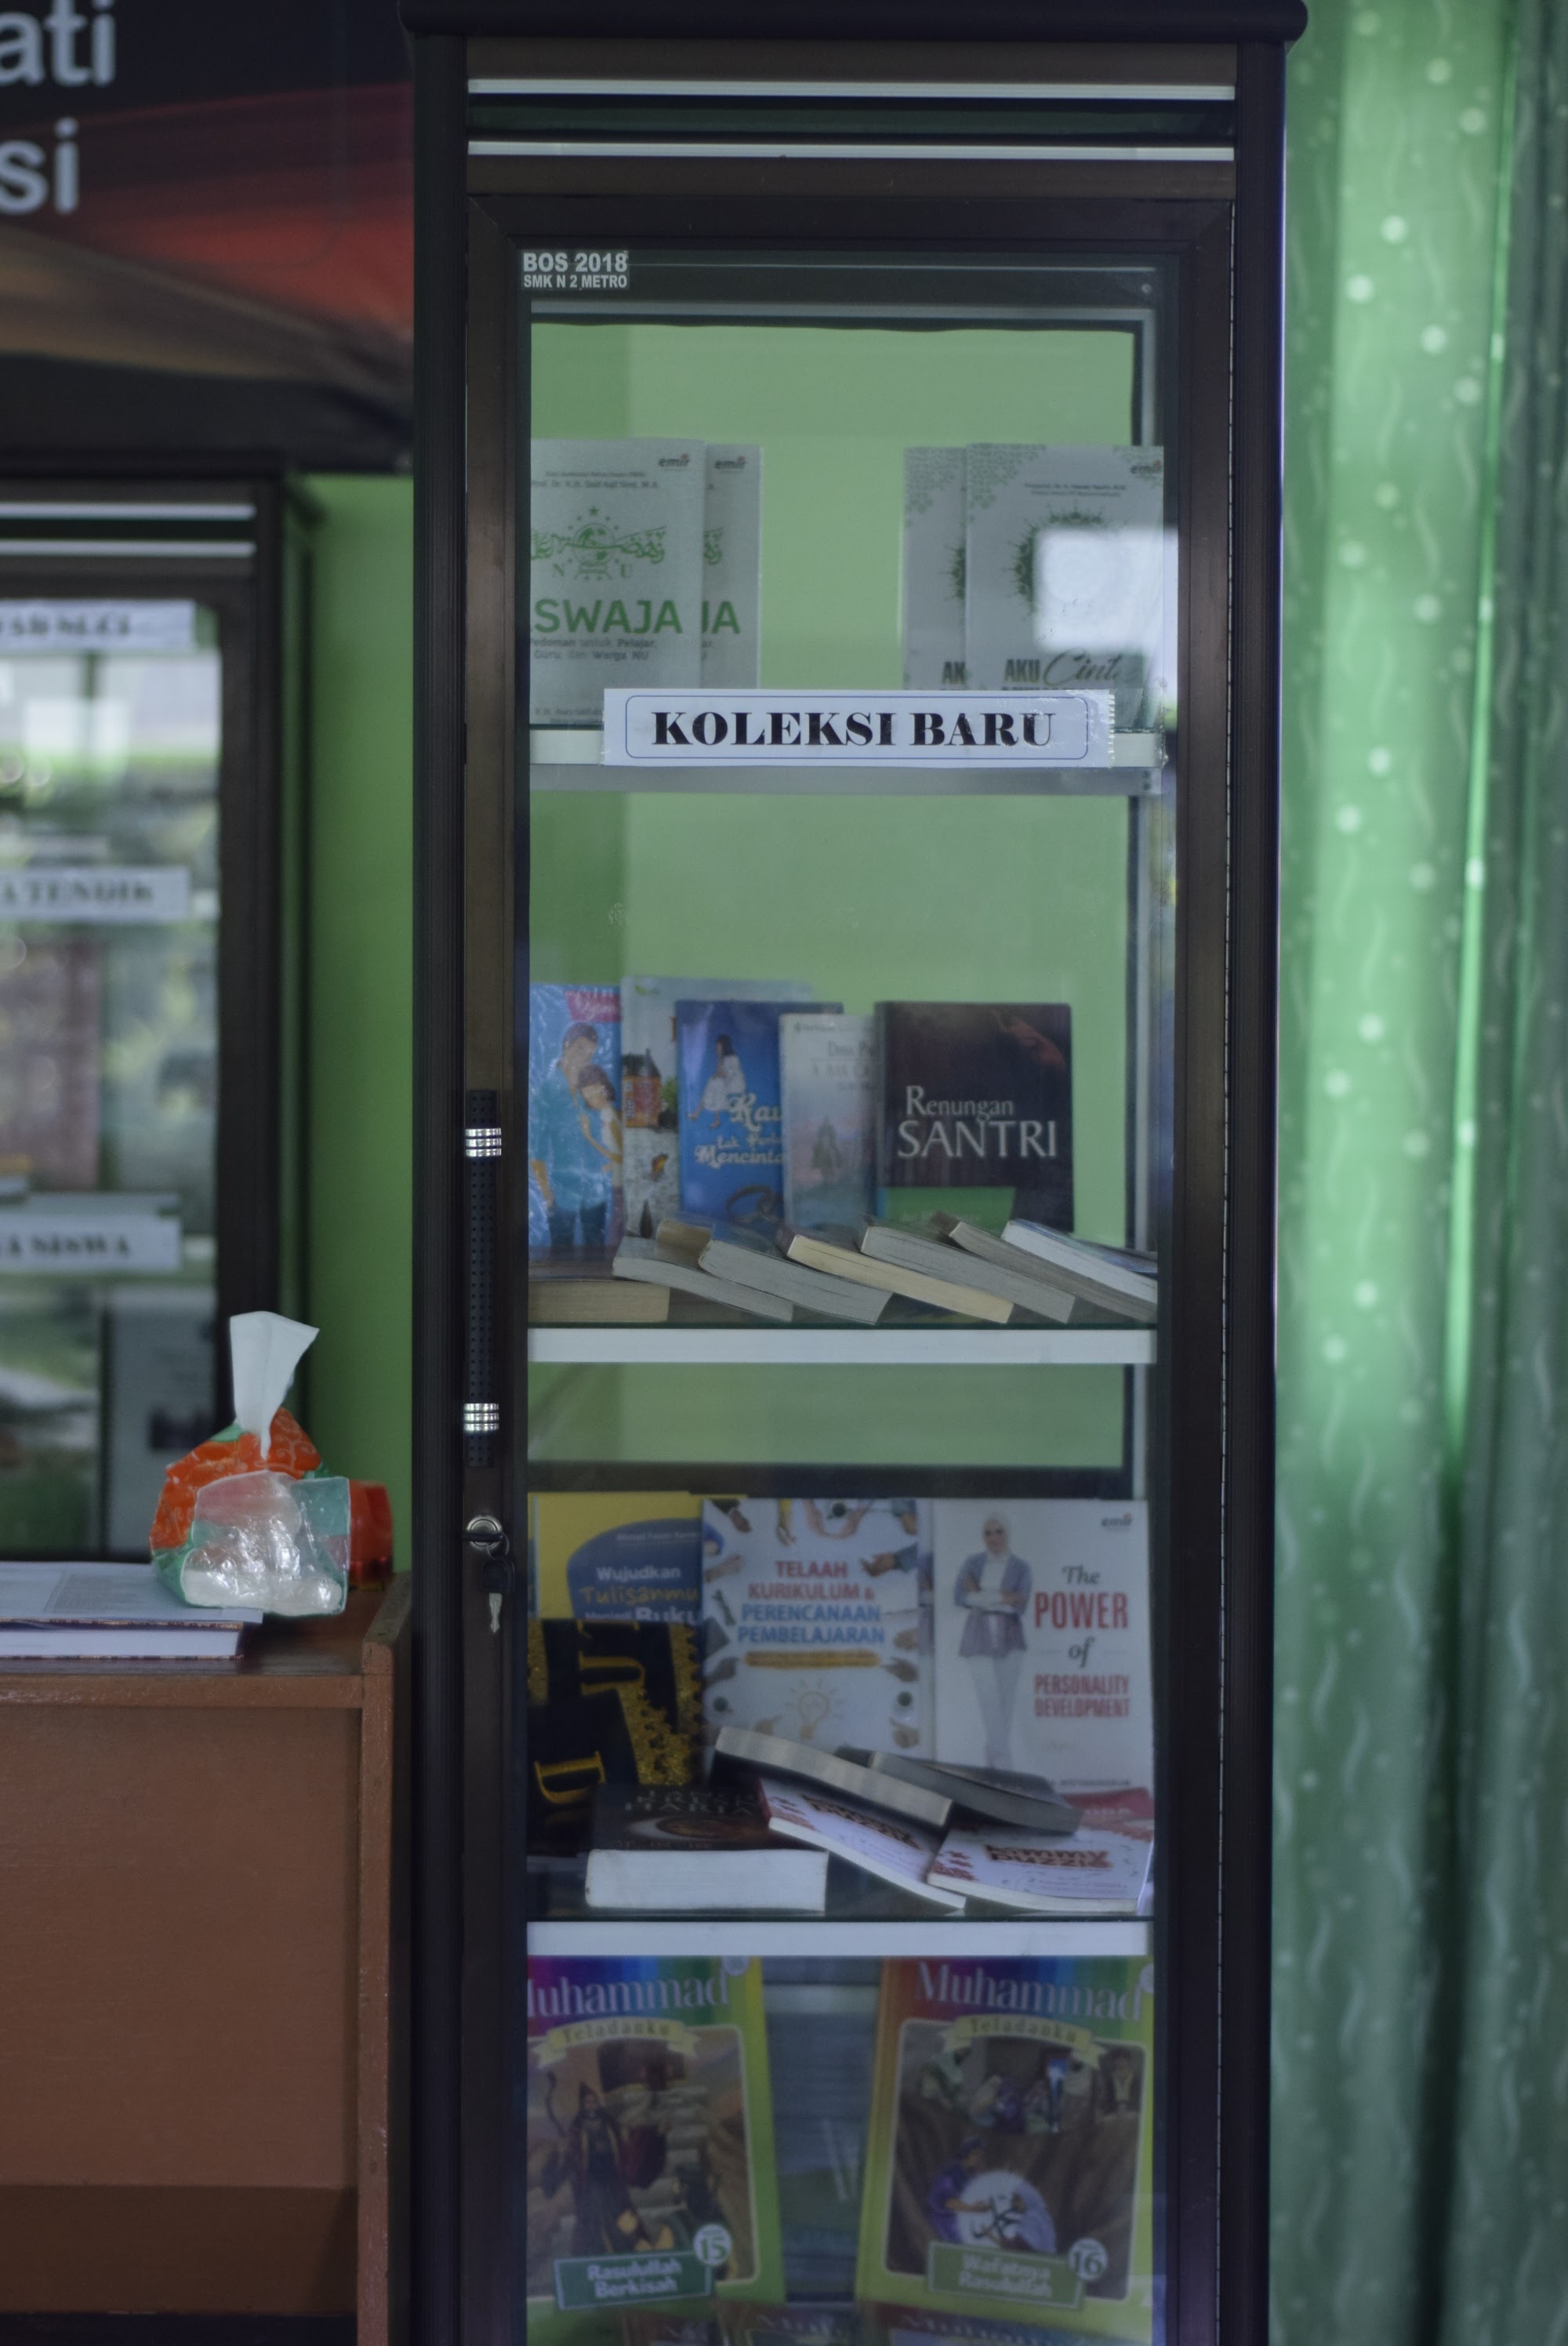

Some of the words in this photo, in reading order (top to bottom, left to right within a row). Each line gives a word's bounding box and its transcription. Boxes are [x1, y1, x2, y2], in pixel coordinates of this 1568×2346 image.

[0, 118, 78, 214] si
[524, 252, 568, 272] BOS
[575, 252, 627, 272] 2018
[524, 274, 553, 288] SMK
[556, 274, 566, 288] N
[569, 274, 578, 288] 2
[581, 274, 627, 288] METRO
[592, 650, 627, 662] Warga
[632, 650, 649, 659] NU
[1004, 659, 1040, 682] AKU
[651, 711, 897, 746] KOLEKSI
[909, 711, 1056, 747] BARU
[906, 1085, 1014, 1123] Renungan
[898, 1120, 1057, 1158] SANTRI
[595, 1565, 681, 1582] Wujudkan
[775, 1560, 848, 1578] TELAAH
[1062, 1564, 1101, 1585] The
[748, 1582, 860, 1600] KURIKULUM
[741, 1603, 882, 1622] PERENCANAAN
[1034, 1592, 1129, 1629] POWER
[737, 1625, 885, 1644] PEMBELAJARAN
[1068, 1636, 1095, 1668] of
[1033, 1673, 1130, 1695] PERSONALITY
[1033, 1697, 1130, 1718] DEVELOPMENT
[528, 1968, 729, 2018] uhammad
[916, 1961, 1143, 2022] Muhammad
[699, 2236, 725, 2260] 15
[1073, 2250, 1102, 2275] 16
